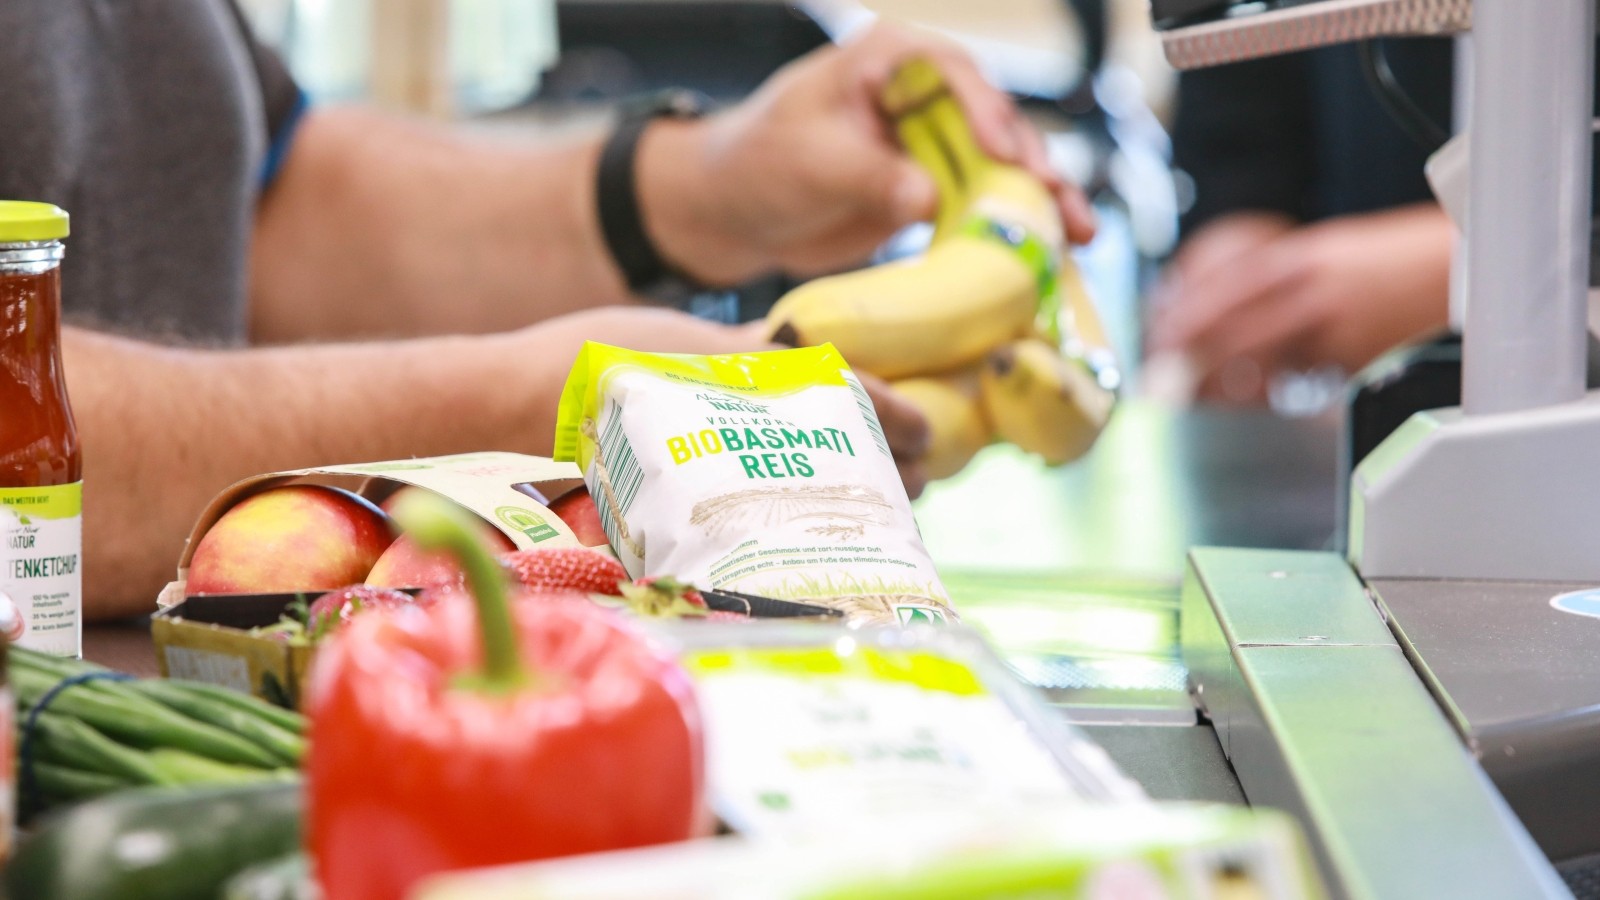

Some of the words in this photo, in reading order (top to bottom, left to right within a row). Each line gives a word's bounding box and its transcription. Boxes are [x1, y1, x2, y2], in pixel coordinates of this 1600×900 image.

[709, 401, 772, 414] NATUR
[738, 452, 815, 479] REIS
[709, 552, 756, 577] Aromatischer
[758, 546, 801, 556] Geschmack
[712, 578, 722, 587] Im
[722, 564, 756, 581] Ursprung
[757, 560, 774, 569] echt
[782, 558, 805, 566] Anbau
